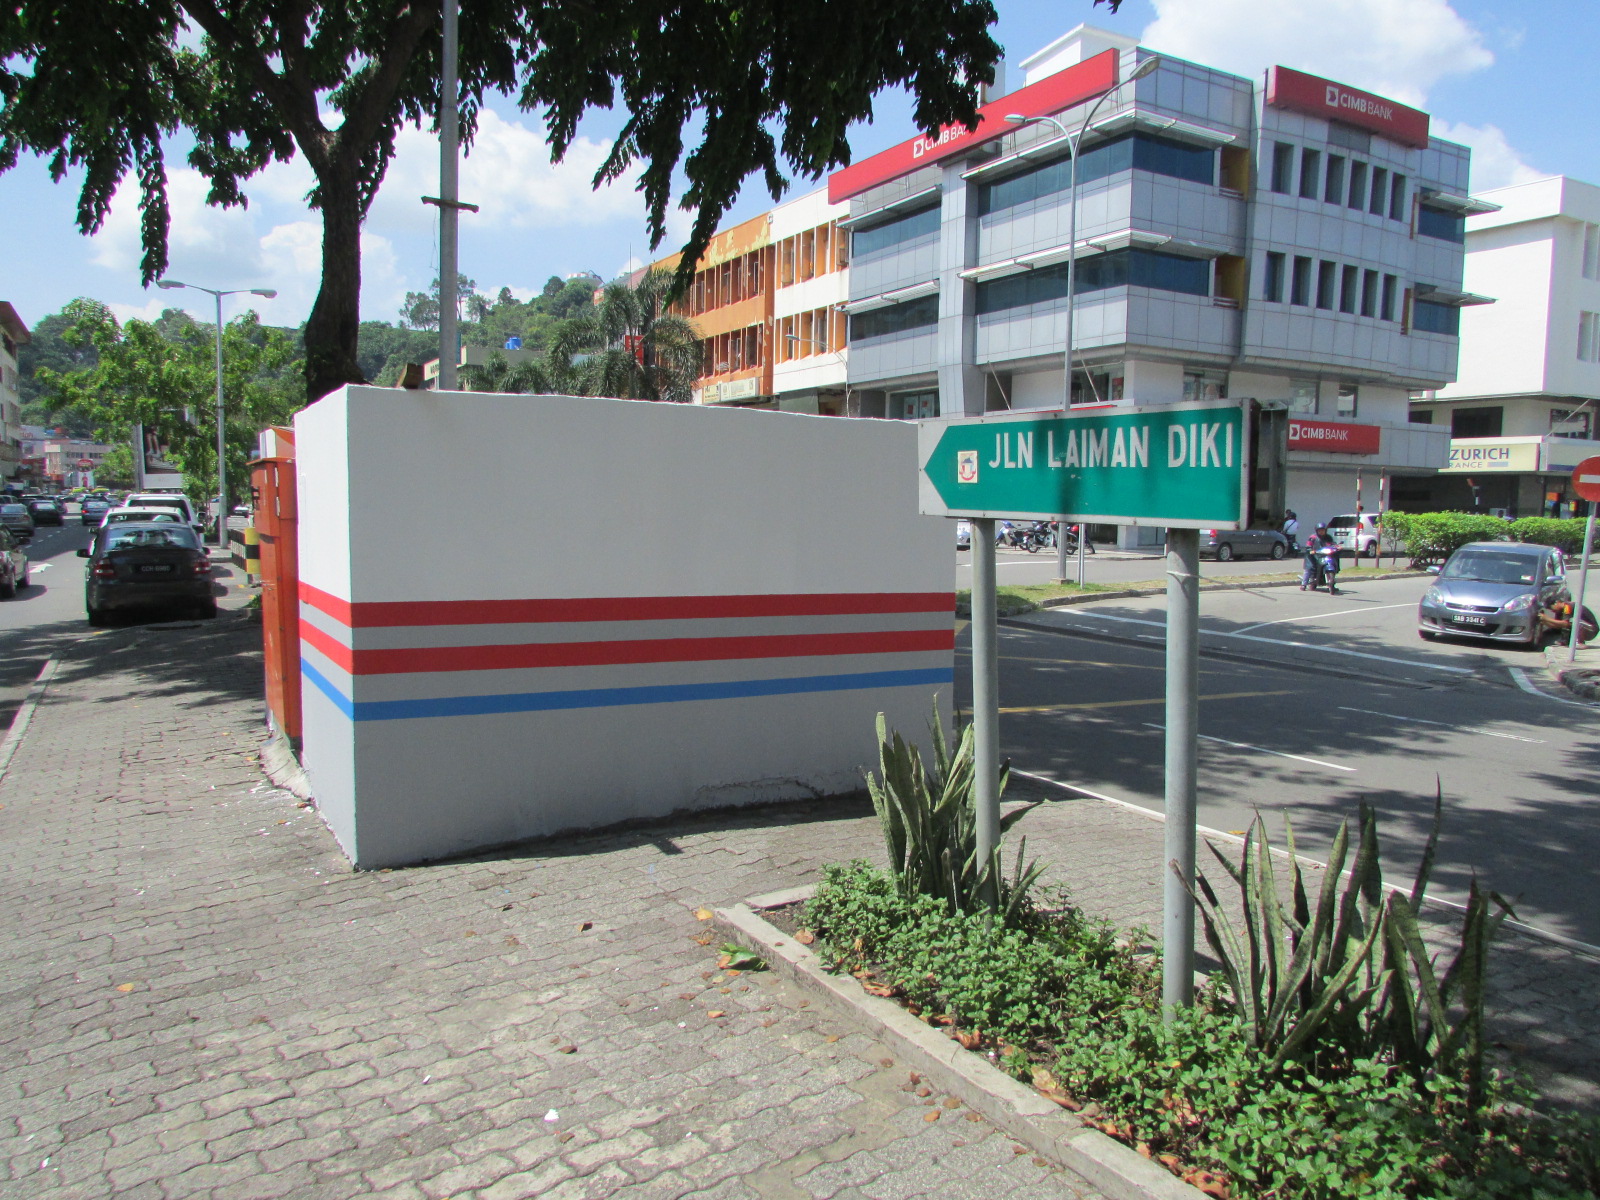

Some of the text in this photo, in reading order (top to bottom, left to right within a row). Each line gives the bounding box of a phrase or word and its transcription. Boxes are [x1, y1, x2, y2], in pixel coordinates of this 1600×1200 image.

[1340, 93, 1393, 120] CIMB BANK
[1301, 427, 1349, 441] CIMB BANK
[988, 422, 1233, 469] JLN LAIMAN DIKI
[1449, 447, 1510, 461] ZURICH
